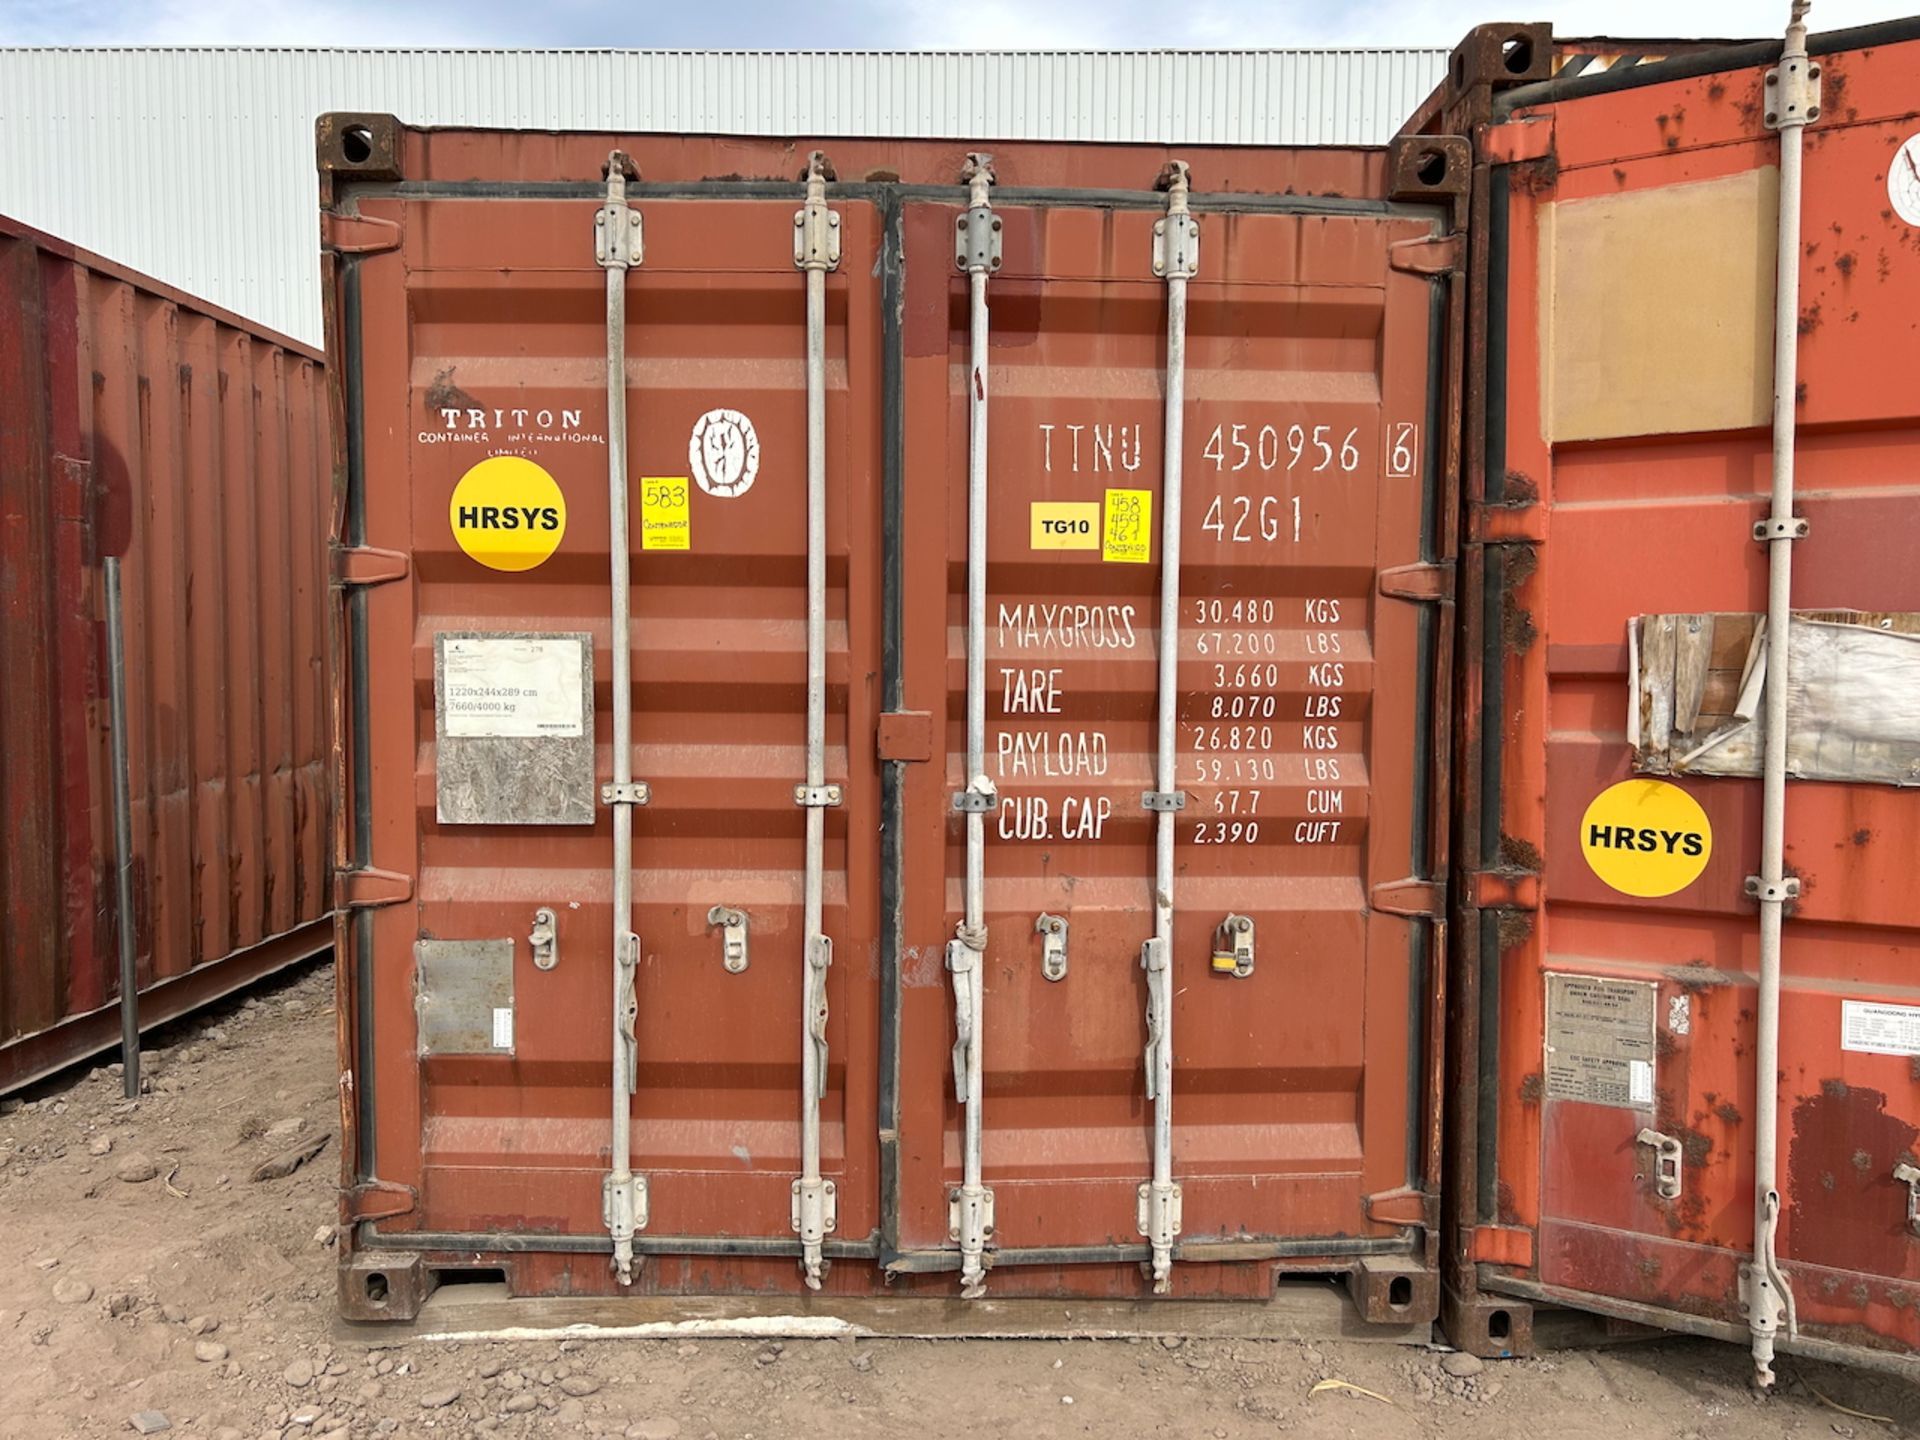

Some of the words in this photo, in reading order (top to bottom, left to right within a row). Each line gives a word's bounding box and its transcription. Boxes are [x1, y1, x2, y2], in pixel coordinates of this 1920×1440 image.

[441, 408, 582, 429] TRITON
[417, 432, 490, 444] CONTAINER
[1039, 424, 1141, 471] TTNU
[1202, 423, 1359, 472] 450956
[1392, 427, 1411, 473] 6
[644, 485, 685, 508] 583
[1111, 495, 1141, 514] 458
[459, 506, 559, 531] HRSYS
[1041, 519, 1090, 535] TG10
[1201, 495, 1301, 542] 42G1
[1109, 528, 1139, 542] 461
[1195, 600, 1275, 624] 30.480
[1305, 599, 1340, 624] KGS
[999, 603, 1136, 649] MAXGROSS
[1196, 632, 1275, 655] 67.200
[1306, 632, 1341, 654] LBS
[1214, 663, 1278, 688] 3.660
[1308, 663, 1344, 687] KGS
[449, 687, 520, 697] 1220x244x289
[523, 689, 538, 697] cm
[1000, 668, 1063, 713] TARE
[449, 701, 501, 712] 7660/4000
[504, 702, 516, 713] kg
[1211, 695, 1276, 718] 8.070
[1304, 695, 1342, 718] LBS
[1194, 726, 1273, 751] 26.820
[1303, 725, 1338, 750] KGS
[998, 732, 1107, 777] PAYLOAD
[1196, 759, 1275, 783] 59.130
[1304, 758, 1340, 781] LBS
[1214, 790, 1261, 815] 67.7
[1307, 790, 1343, 814] CUM
[998, 797, 1053, 840] CUB.
[1061, 797, 1111, 840] CAP
[1193, 822, 1259, 844] 2.390
[1294, 821, 1342, 843] CUFT
[1589, 824, 1704, 856] HRSYS
